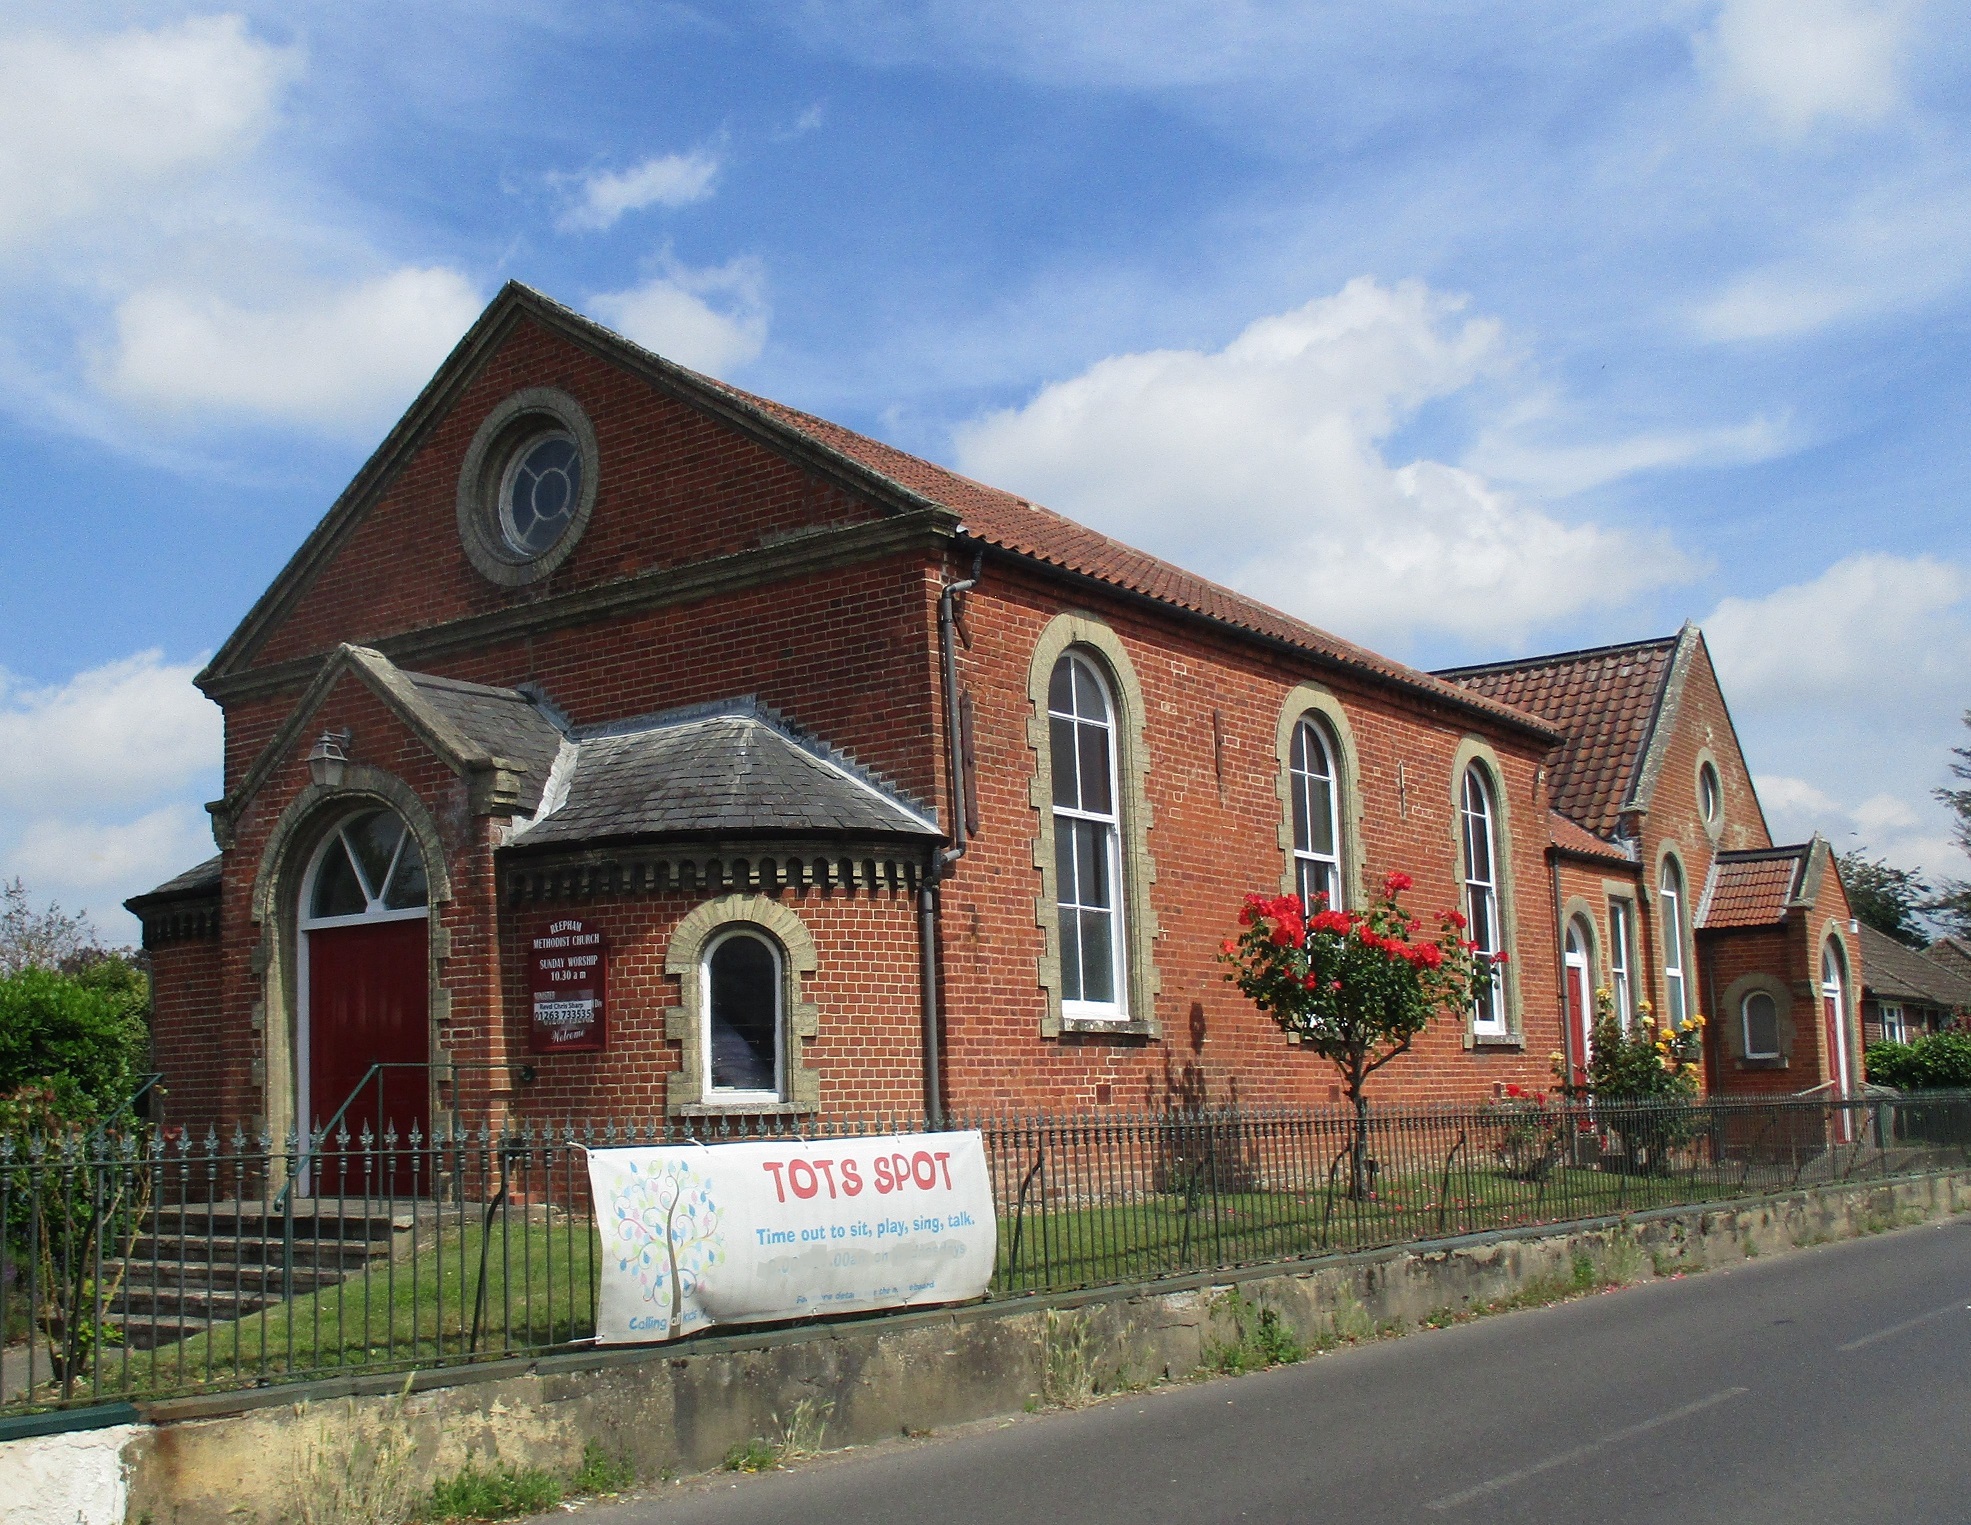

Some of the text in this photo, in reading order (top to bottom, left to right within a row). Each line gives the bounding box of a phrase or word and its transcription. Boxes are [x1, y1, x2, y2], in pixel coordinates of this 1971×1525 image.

[550, 920, 582, 935] REEPHAM
[533, 933, 600, 949] METHODIST CHURCH
[539, 955, 598, 970] SUNDAY WORSHIP
[551, 970, 571, 981] 10.30
[568, 1002, 584, 1010] Sharp
[534, 1010, 560, 1020] 01263
[561, 1009, 591, 1019] 733535
[551, 1029, 585, 1043] Welcome
[762, 1150, 952, 1203] TOTS SPOT
[756, 1211, 975, 1245] Time out to sit, play, sing, talk.
[629, 1316, 667, 1331] Calling
